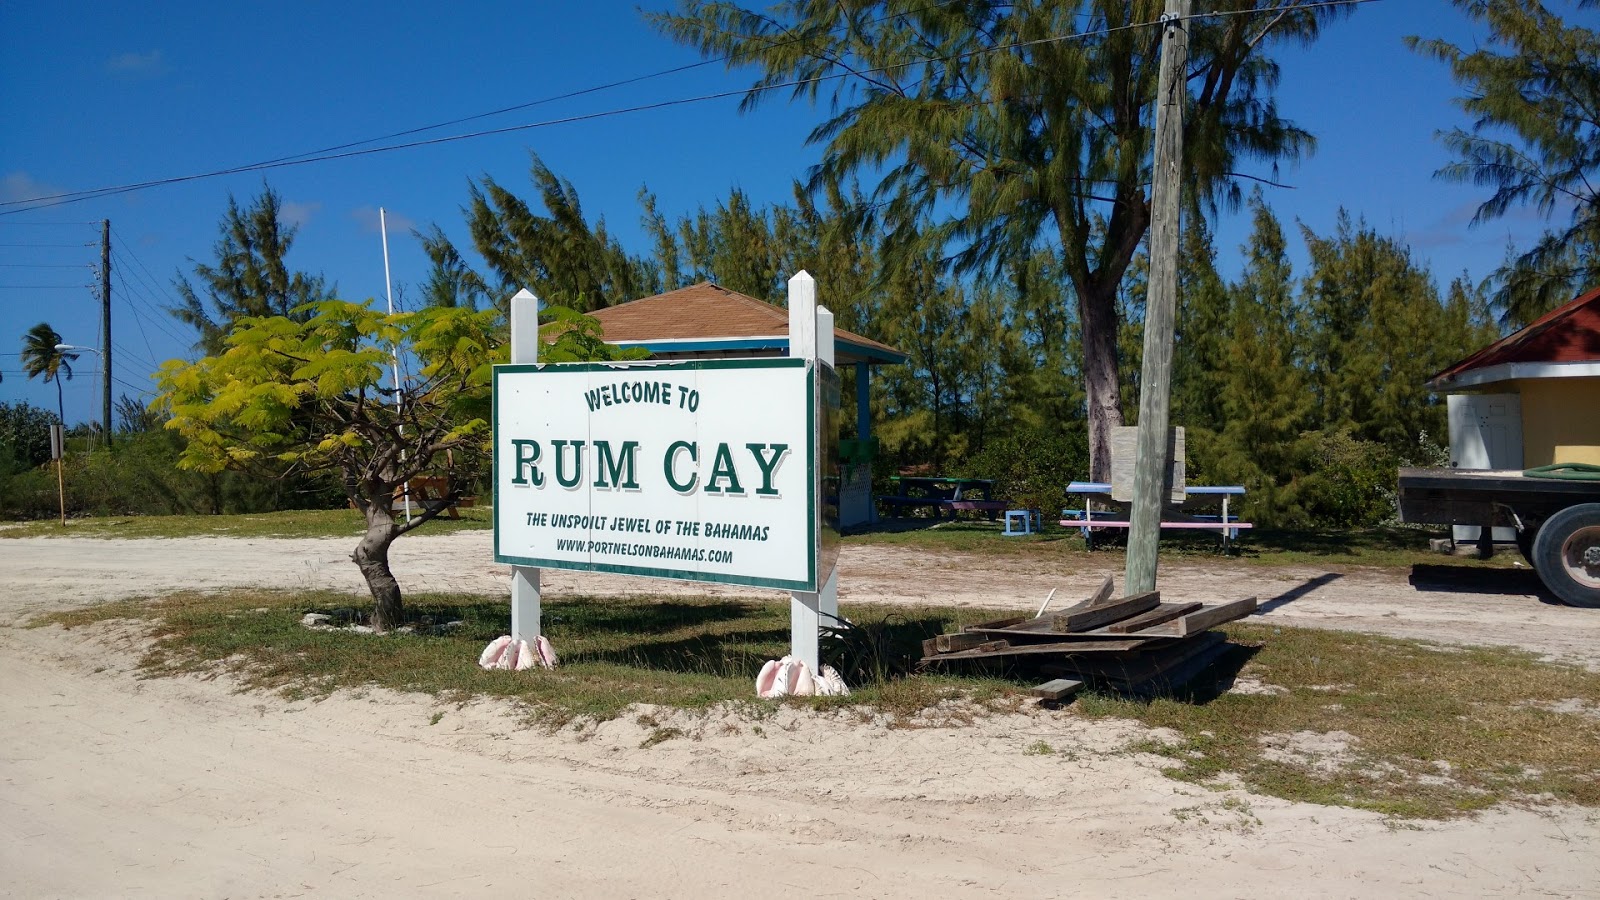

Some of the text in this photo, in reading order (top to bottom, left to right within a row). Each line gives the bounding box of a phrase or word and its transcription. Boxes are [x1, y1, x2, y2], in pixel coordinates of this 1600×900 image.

[584, 381, 700, 413] WELCOME TO
[511, 439, 792, 498] RUM CAY
[526, 512, 770, 542] THE UNSPOILT JEWEL OF THE BAHAMAS
[556, 539, 733, 564] WWW.PORTNELSONBAHAMAS.COM
